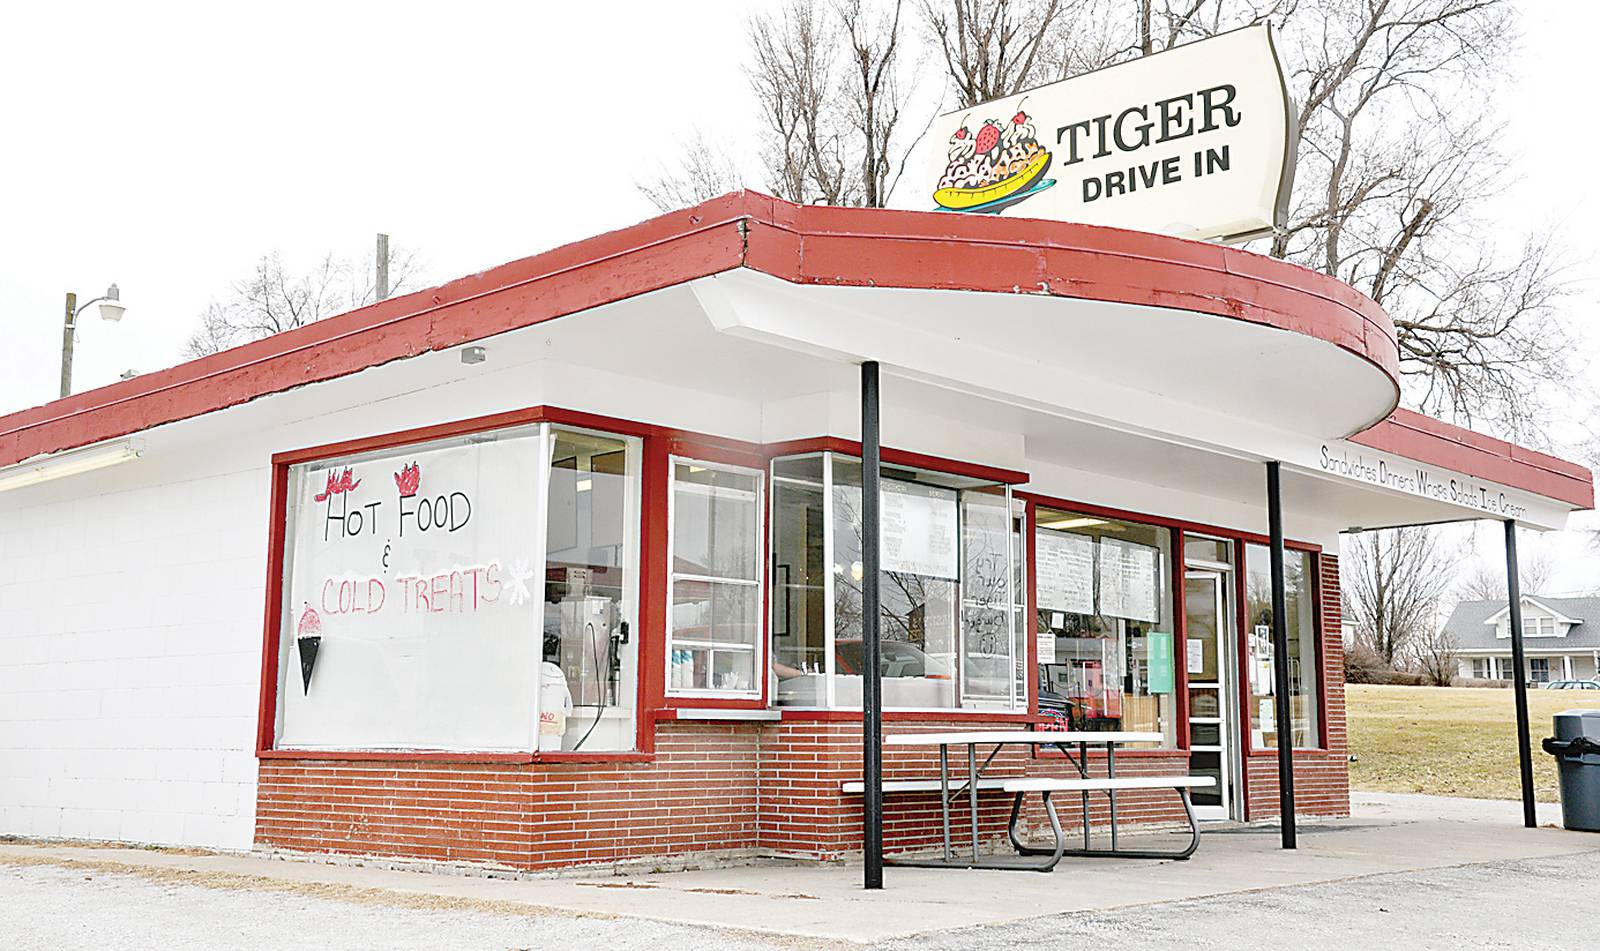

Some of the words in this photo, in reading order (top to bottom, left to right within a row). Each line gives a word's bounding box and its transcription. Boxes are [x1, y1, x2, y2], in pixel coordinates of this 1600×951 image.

[1056, 84, 1242, 166] TIGER
[1082, 156, 1182, 203] DRIVE
[1193, 145, 1231, 177] IN
[1320, 445, 1376, 482] Sandwiches
[1379, 460, 1414, 491] Dinners
[1416, 469, 1447, 500] Wraps
[1450, 479, 1478, 508] Salads
[1479, 487, 1497, 512] Ice
[1499, 492, 1527, 521] Cream
[324, 490, 382, 542] HOT
[400, 492, 471, 537] FOOD
[321, 578, 387, 615] COLD
[396, 563, 502, 614] TREATS
